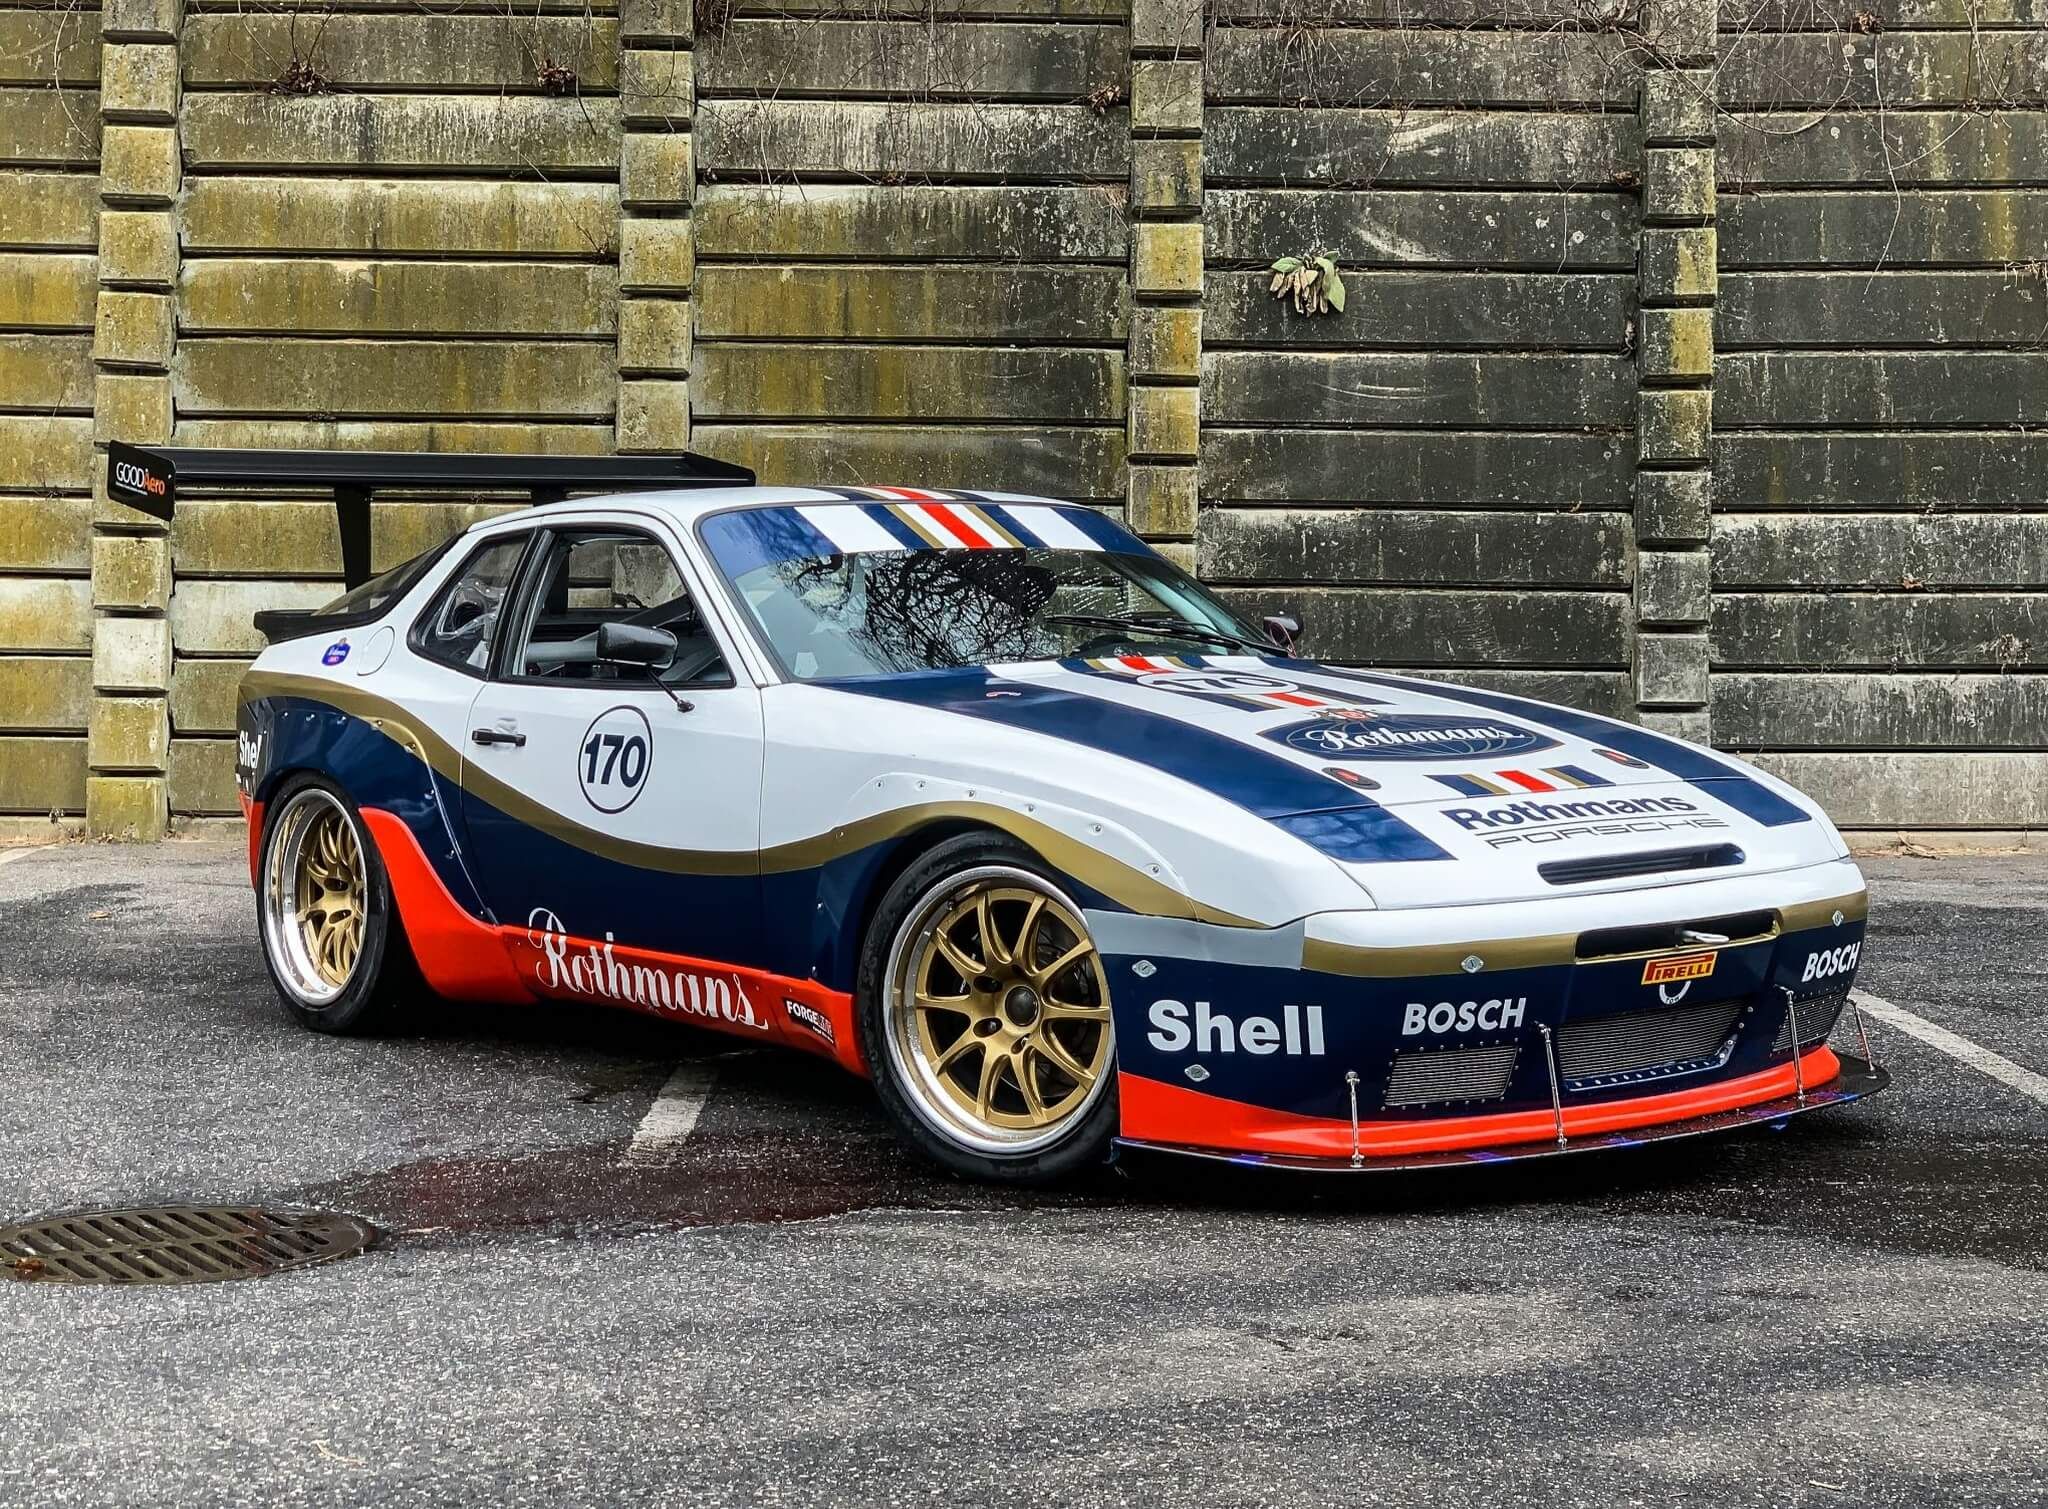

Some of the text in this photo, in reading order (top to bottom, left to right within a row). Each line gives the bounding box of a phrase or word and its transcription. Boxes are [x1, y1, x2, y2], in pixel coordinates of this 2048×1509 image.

[1153, 677, 1288, 690] 170
[1306, 726, 1525, 750] Rothmans
[584, 733, 647, 788] 170
[1440, 796, 1698, 831] Rothmans
[1484, 818, 1731, 849] PORSCHE
[528, 907, 769, 1030] Rothmans
[1645, 953, 1714, 982] PIRELLI
[1801, 941, 1861, 983] BOSCH
[1147, 1000, 1325, 1056] Shell
[1402, 997, 1526, 1036] BOSCH
